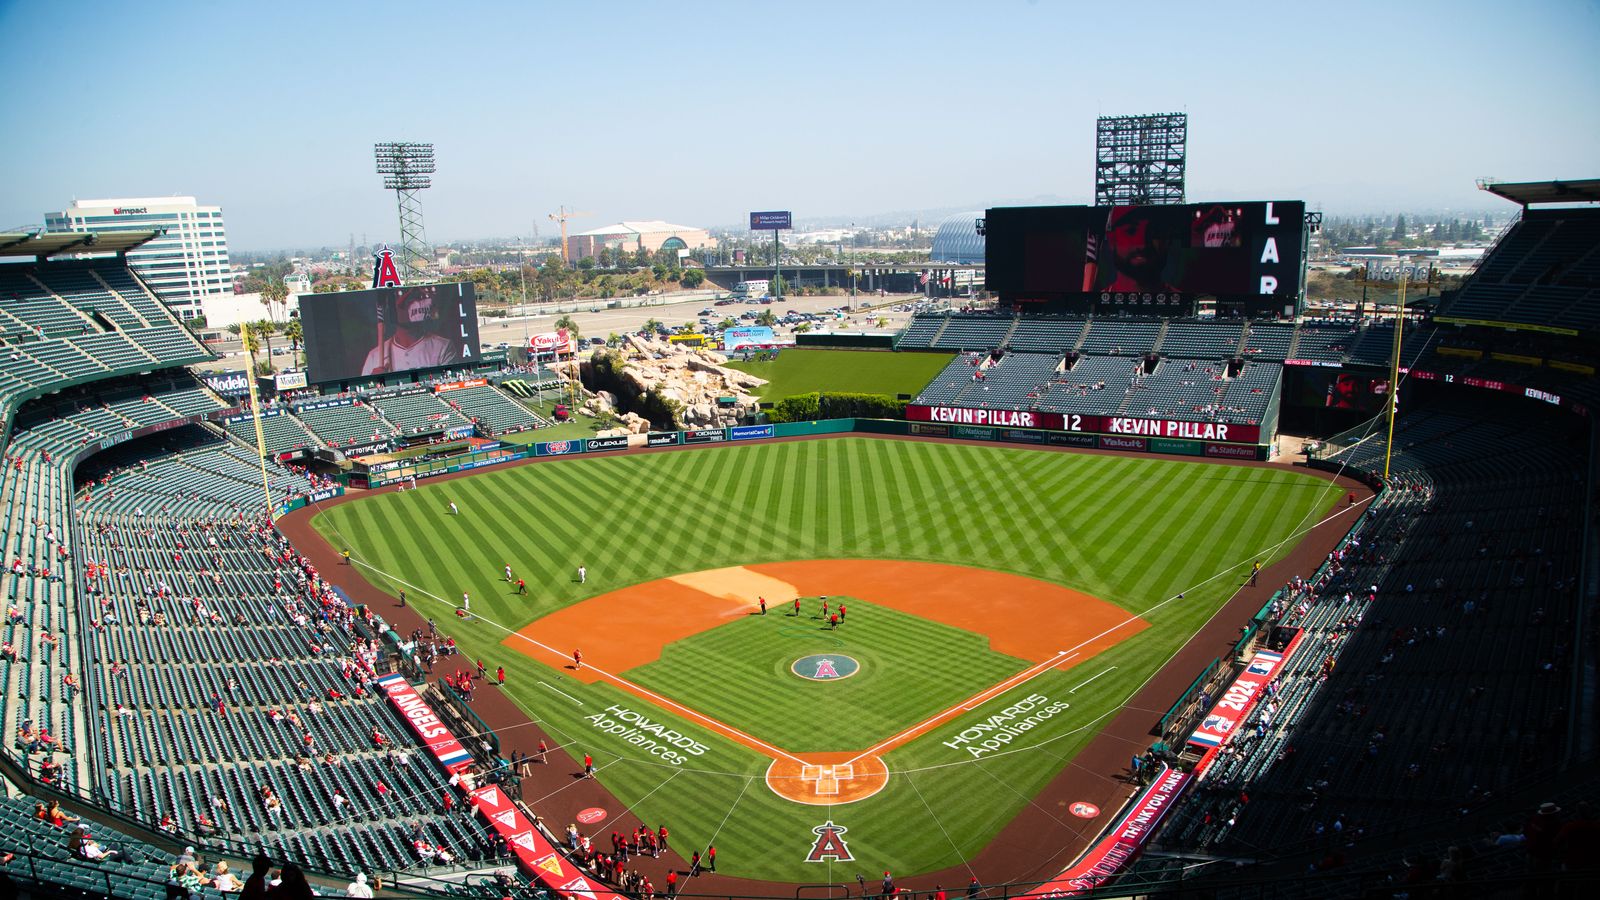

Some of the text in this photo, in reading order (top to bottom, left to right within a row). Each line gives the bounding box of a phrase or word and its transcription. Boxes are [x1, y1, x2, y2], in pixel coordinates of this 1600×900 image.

[1367, 259, 1429, 281] Modelo
[206, 375, 248, 392] Modelo
[931, 406, 1033, 427] KEVIN PILLAR
[1062, 414, 1082, 431] 12
[964, 428, 993, 436] National
[1112, 417, 1227, 440] KEVIN PILLAR
[1103, 438, 1143, 448] Yakult
[1218, 679, 1260, 711] 2024
[393, 693, 447, 739] ANGELS
[584, 713, 688, 765] Appliances
[966, 701, 1069, 758] Appliances
